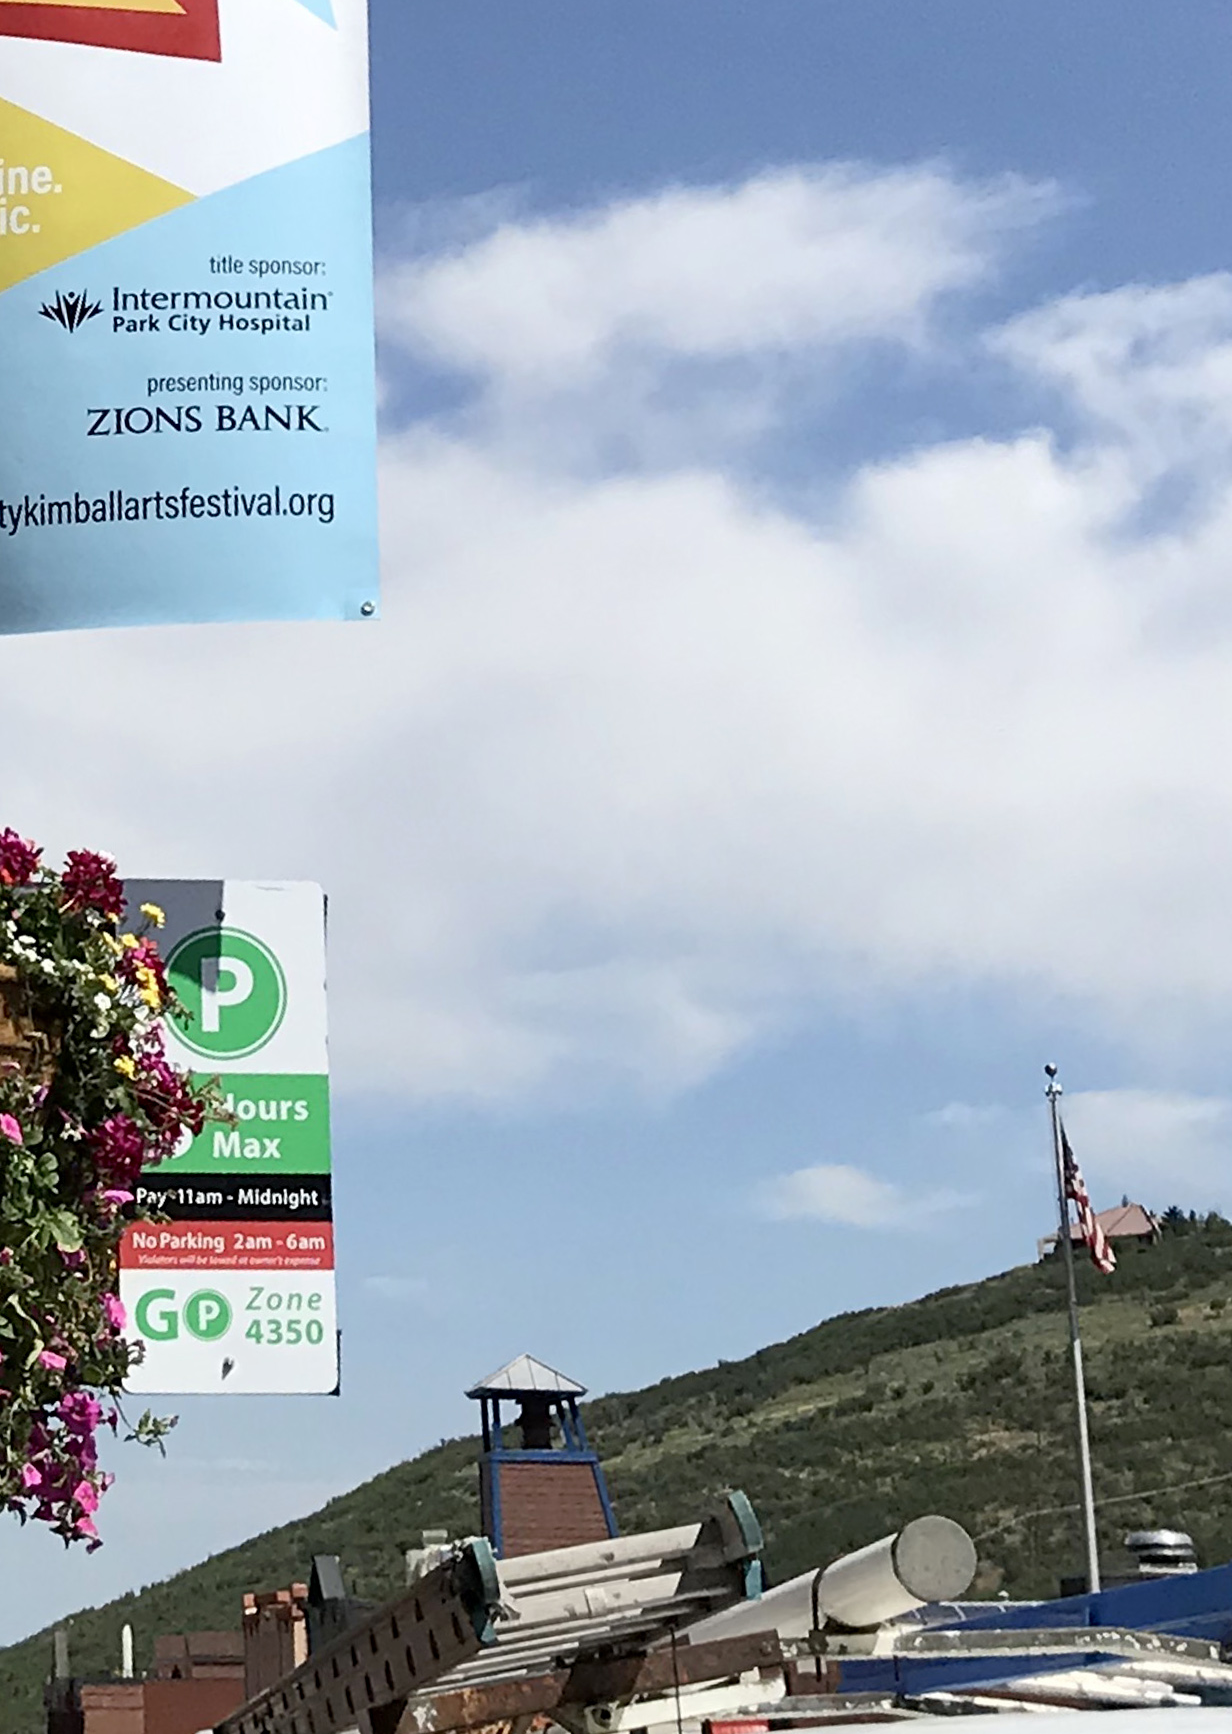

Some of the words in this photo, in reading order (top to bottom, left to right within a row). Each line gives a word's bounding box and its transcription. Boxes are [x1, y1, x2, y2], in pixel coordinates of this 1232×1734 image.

[209, 255, 244, 275] title
[248, 259, 327, 279] sponsor:
[112, 286, 330, 312] Intermountain
[113, 314, 160, 333] Park
[168, 314, 211, 335] City
[219, 314, 311, 335] Hospital
[147, 372, 244, 397] presenting
[248, 375, 328, 396] sponsor:
[86, 405, 202, 437] ZIONS
[215, 404, 323, 432] BANK
[200, 956, 254, 1033] P
[212, 1130, 282, 1159] Max
[178, 1188, 223, 1205] 11am
[237, 1188, 319, 1209] Midnight
[132, 1232, 157, 1249] No
[160, 1232, 225, 1253] Parking
[233, 1233, 272, 1250] 2am
[286, 1233, 325, 1250] 6am
[245, 1286, 322, 1311] Zone
[245, 1319, 323, 1345] 4350
